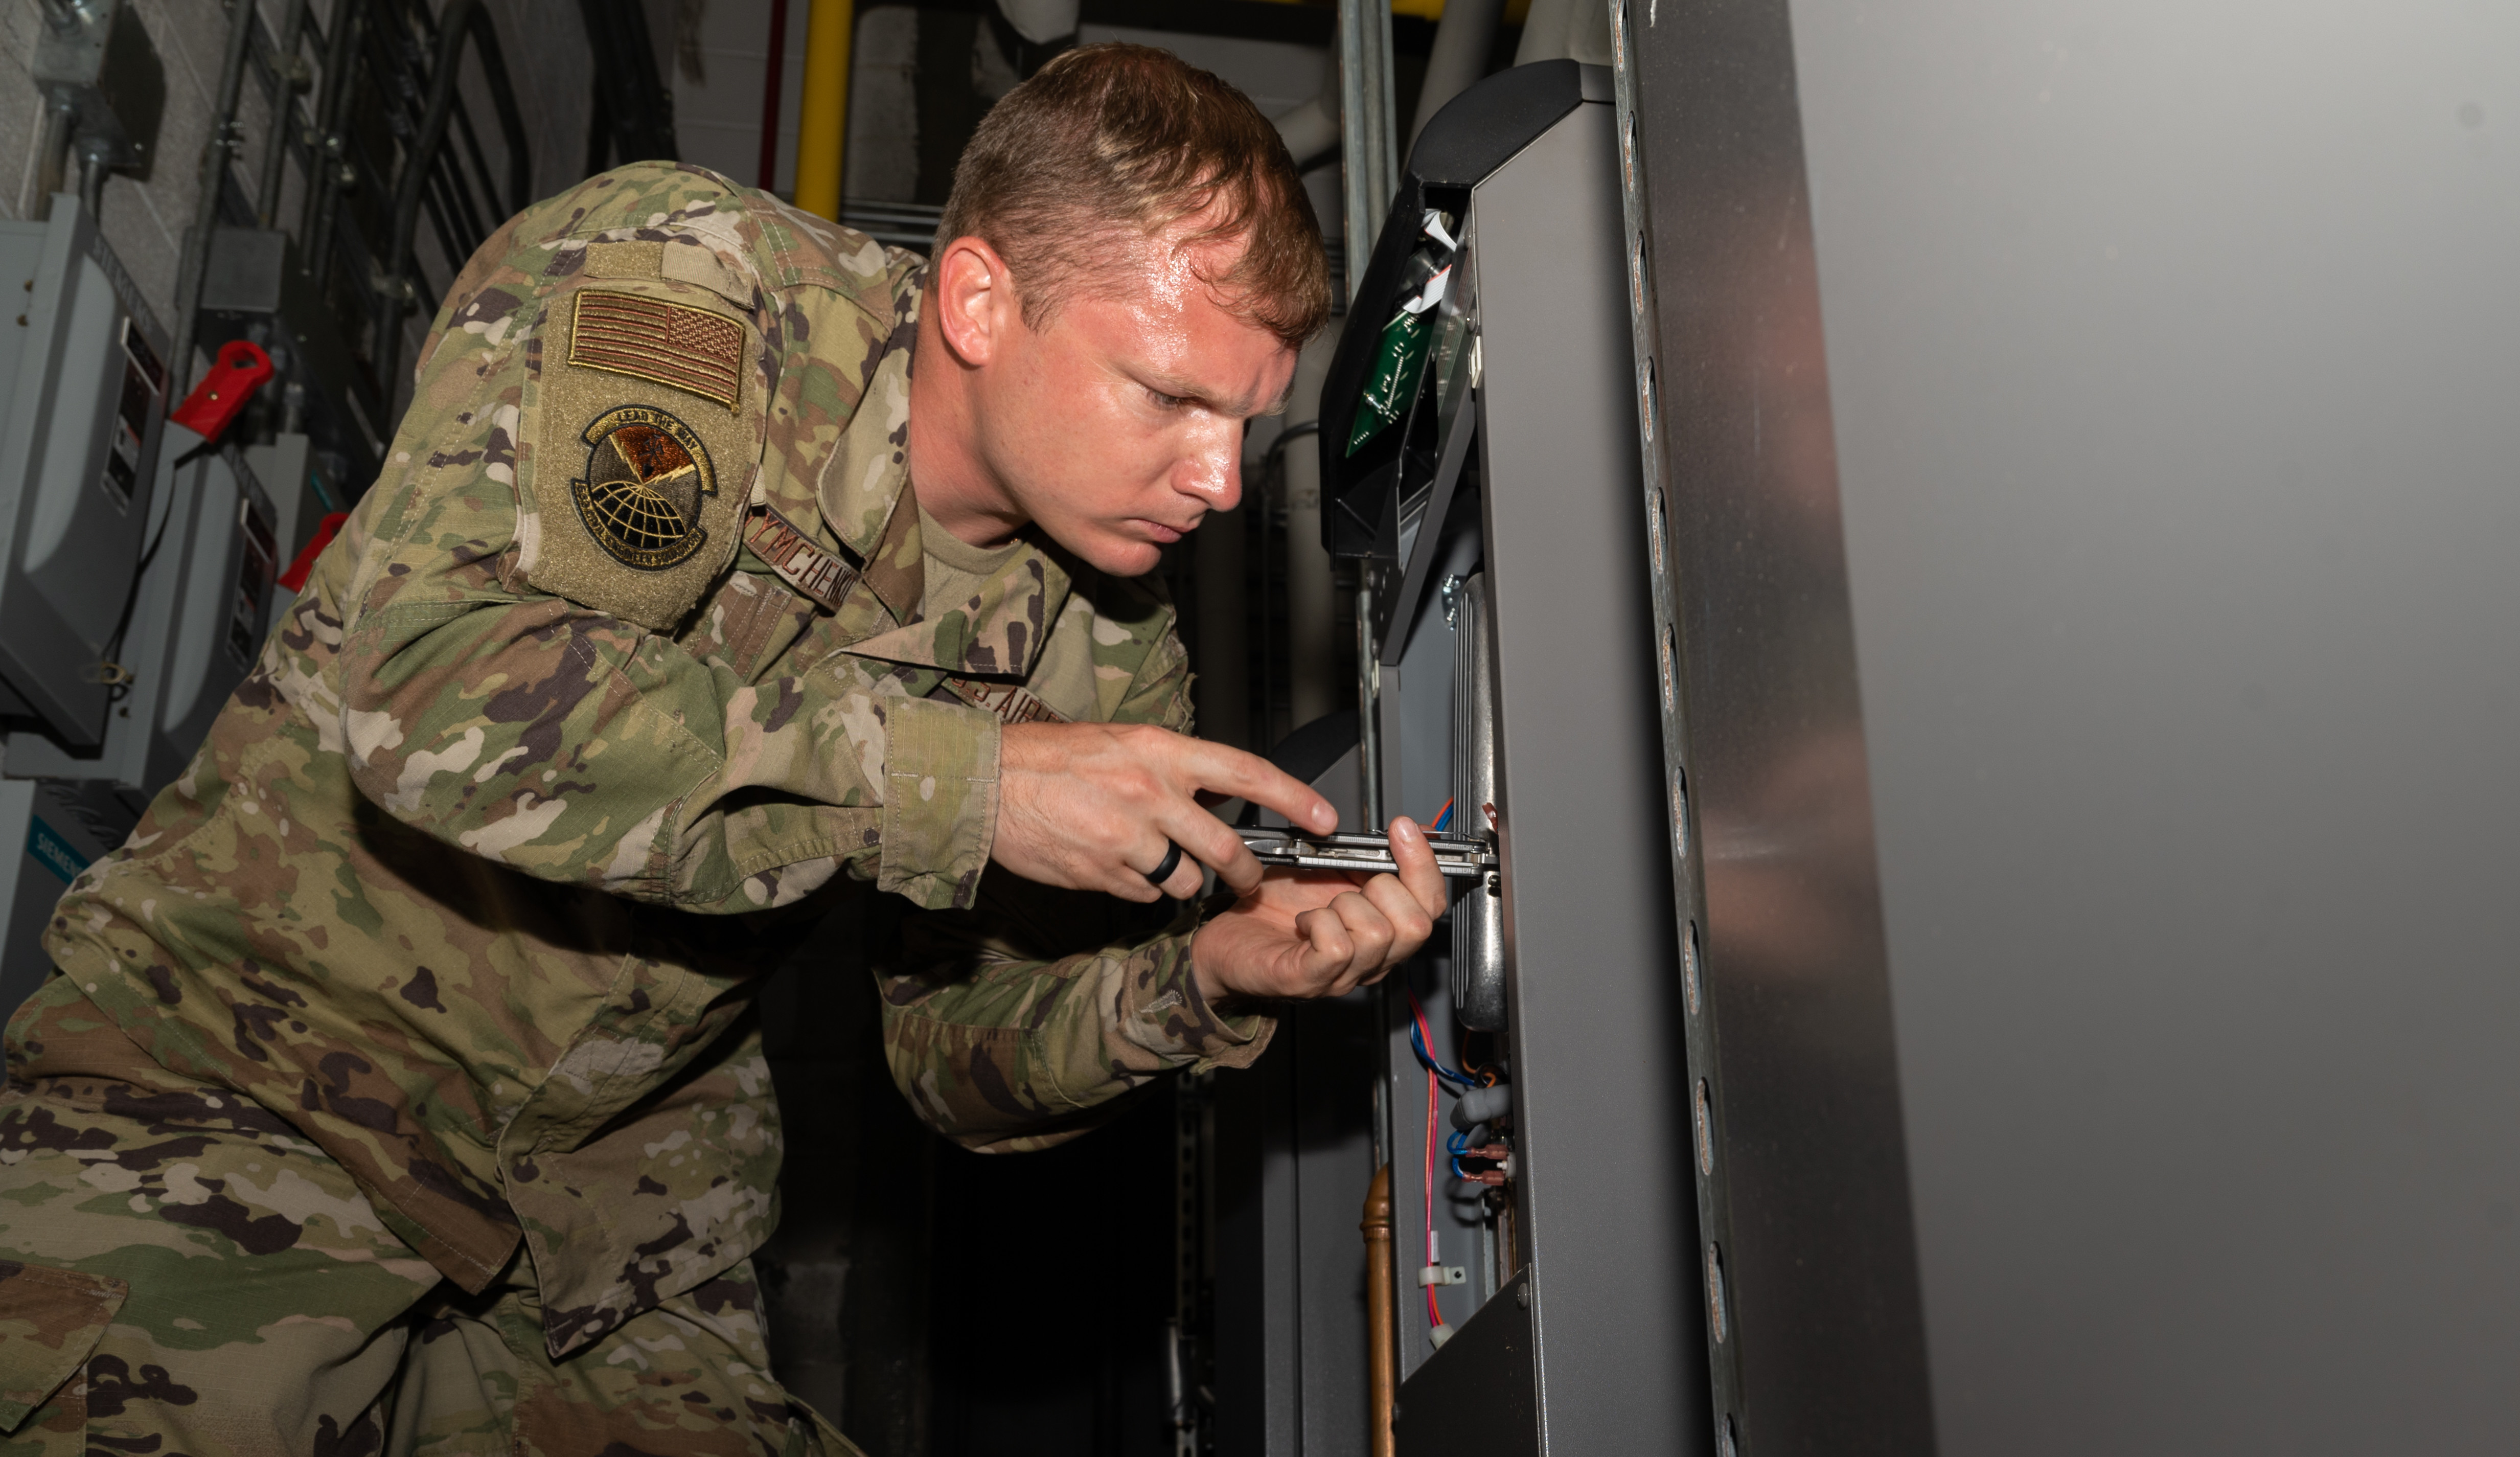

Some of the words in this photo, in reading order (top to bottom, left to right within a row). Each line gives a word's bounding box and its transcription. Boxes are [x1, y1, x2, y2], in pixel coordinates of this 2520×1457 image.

[618, 410, 648, 422] LEAD
[652, 413, 674, 430] THE
[675, 427, 698, 449] WAY
[993, 686, 1041, 723] AIR
[37, 833, 83, 877] SIEMEN
